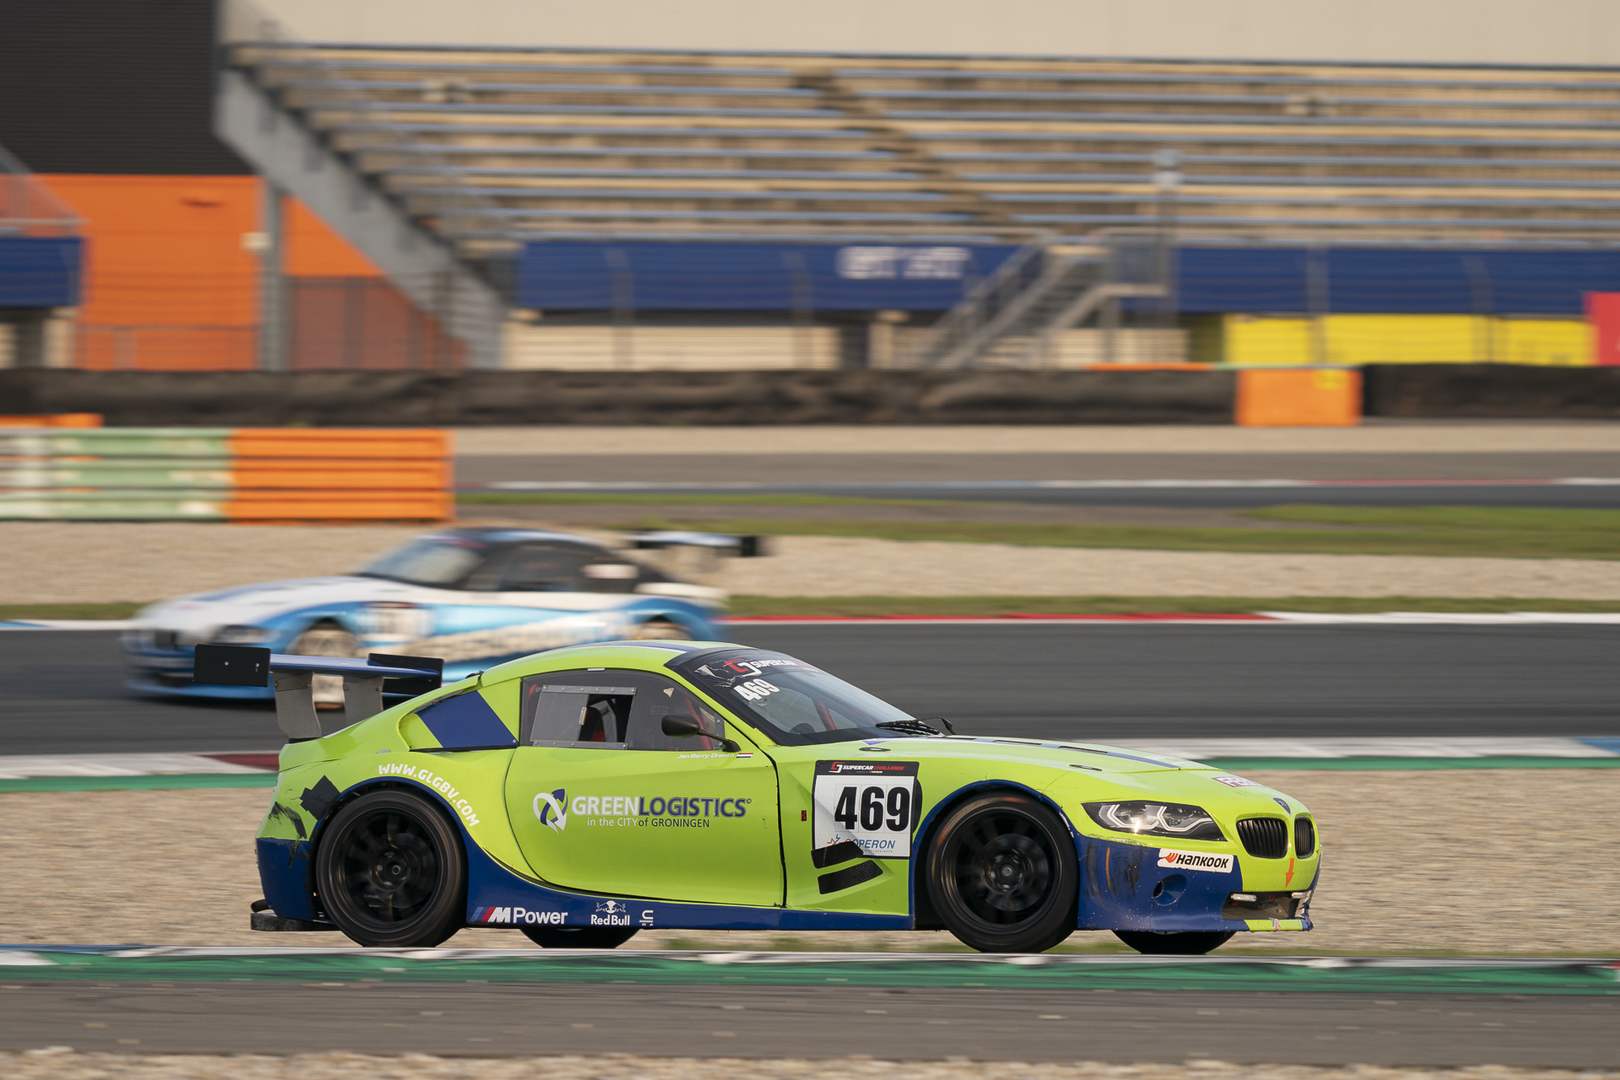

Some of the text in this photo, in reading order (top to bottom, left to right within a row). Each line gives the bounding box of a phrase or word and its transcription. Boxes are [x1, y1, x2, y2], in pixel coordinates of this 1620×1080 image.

[733, 678, 780, 701] 469
[378, 763, 480, 827] WWW.GLGBV.COM
[834, 786, 910, 832] 469
[587, 817, 596, 826] in
[599, 818, 615, 827] the
[651, 818, 710, 828] GRONINGEN
[845, 838, 896, 849] OPERON
[513, 907, 569, 925] Power
[590, 914, 611, 926] Red
[611, 915, 631, 926] Bull
